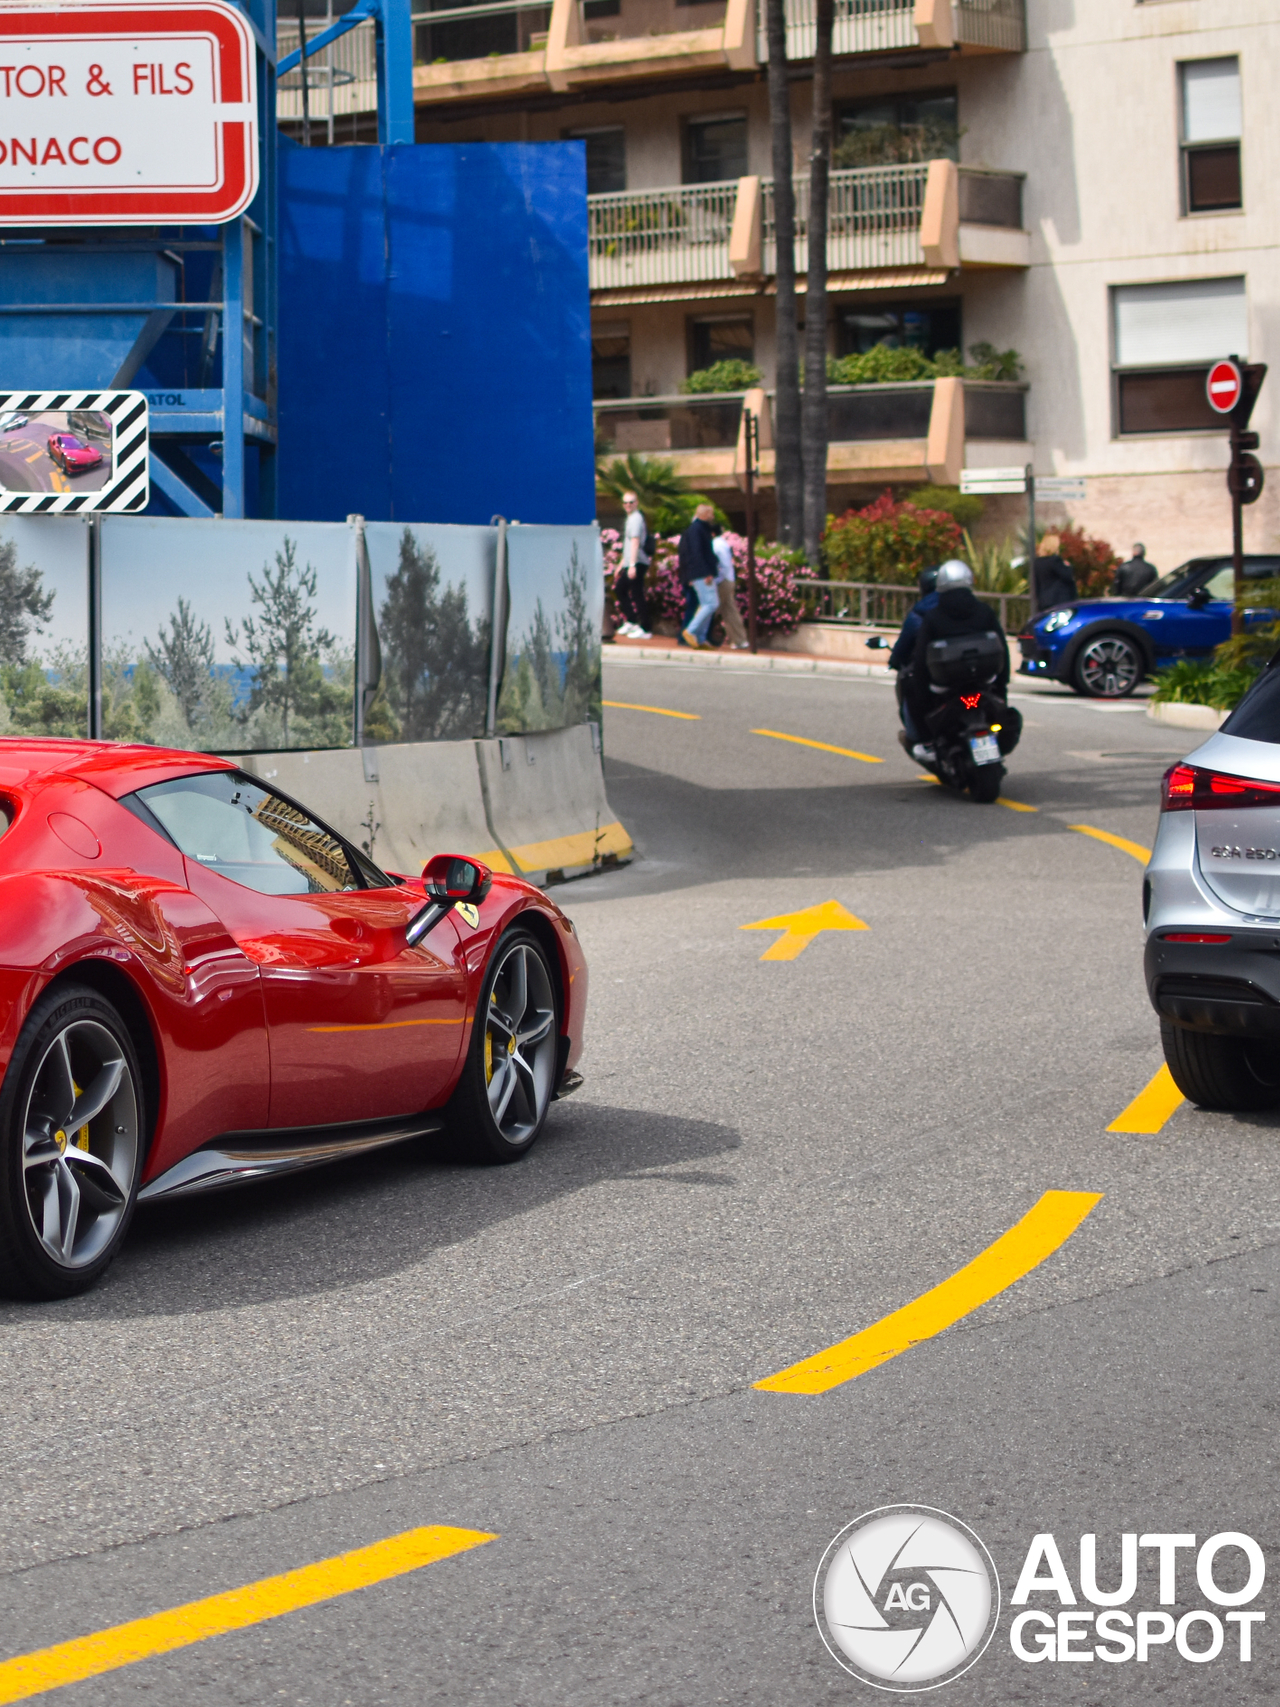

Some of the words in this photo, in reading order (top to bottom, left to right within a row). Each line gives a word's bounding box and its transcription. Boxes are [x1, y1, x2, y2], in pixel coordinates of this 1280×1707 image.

[86, 63, 113, 97] &
[132, 61, 194, 96] FILS
[49, 997, 92, 1028] MICHELIN
